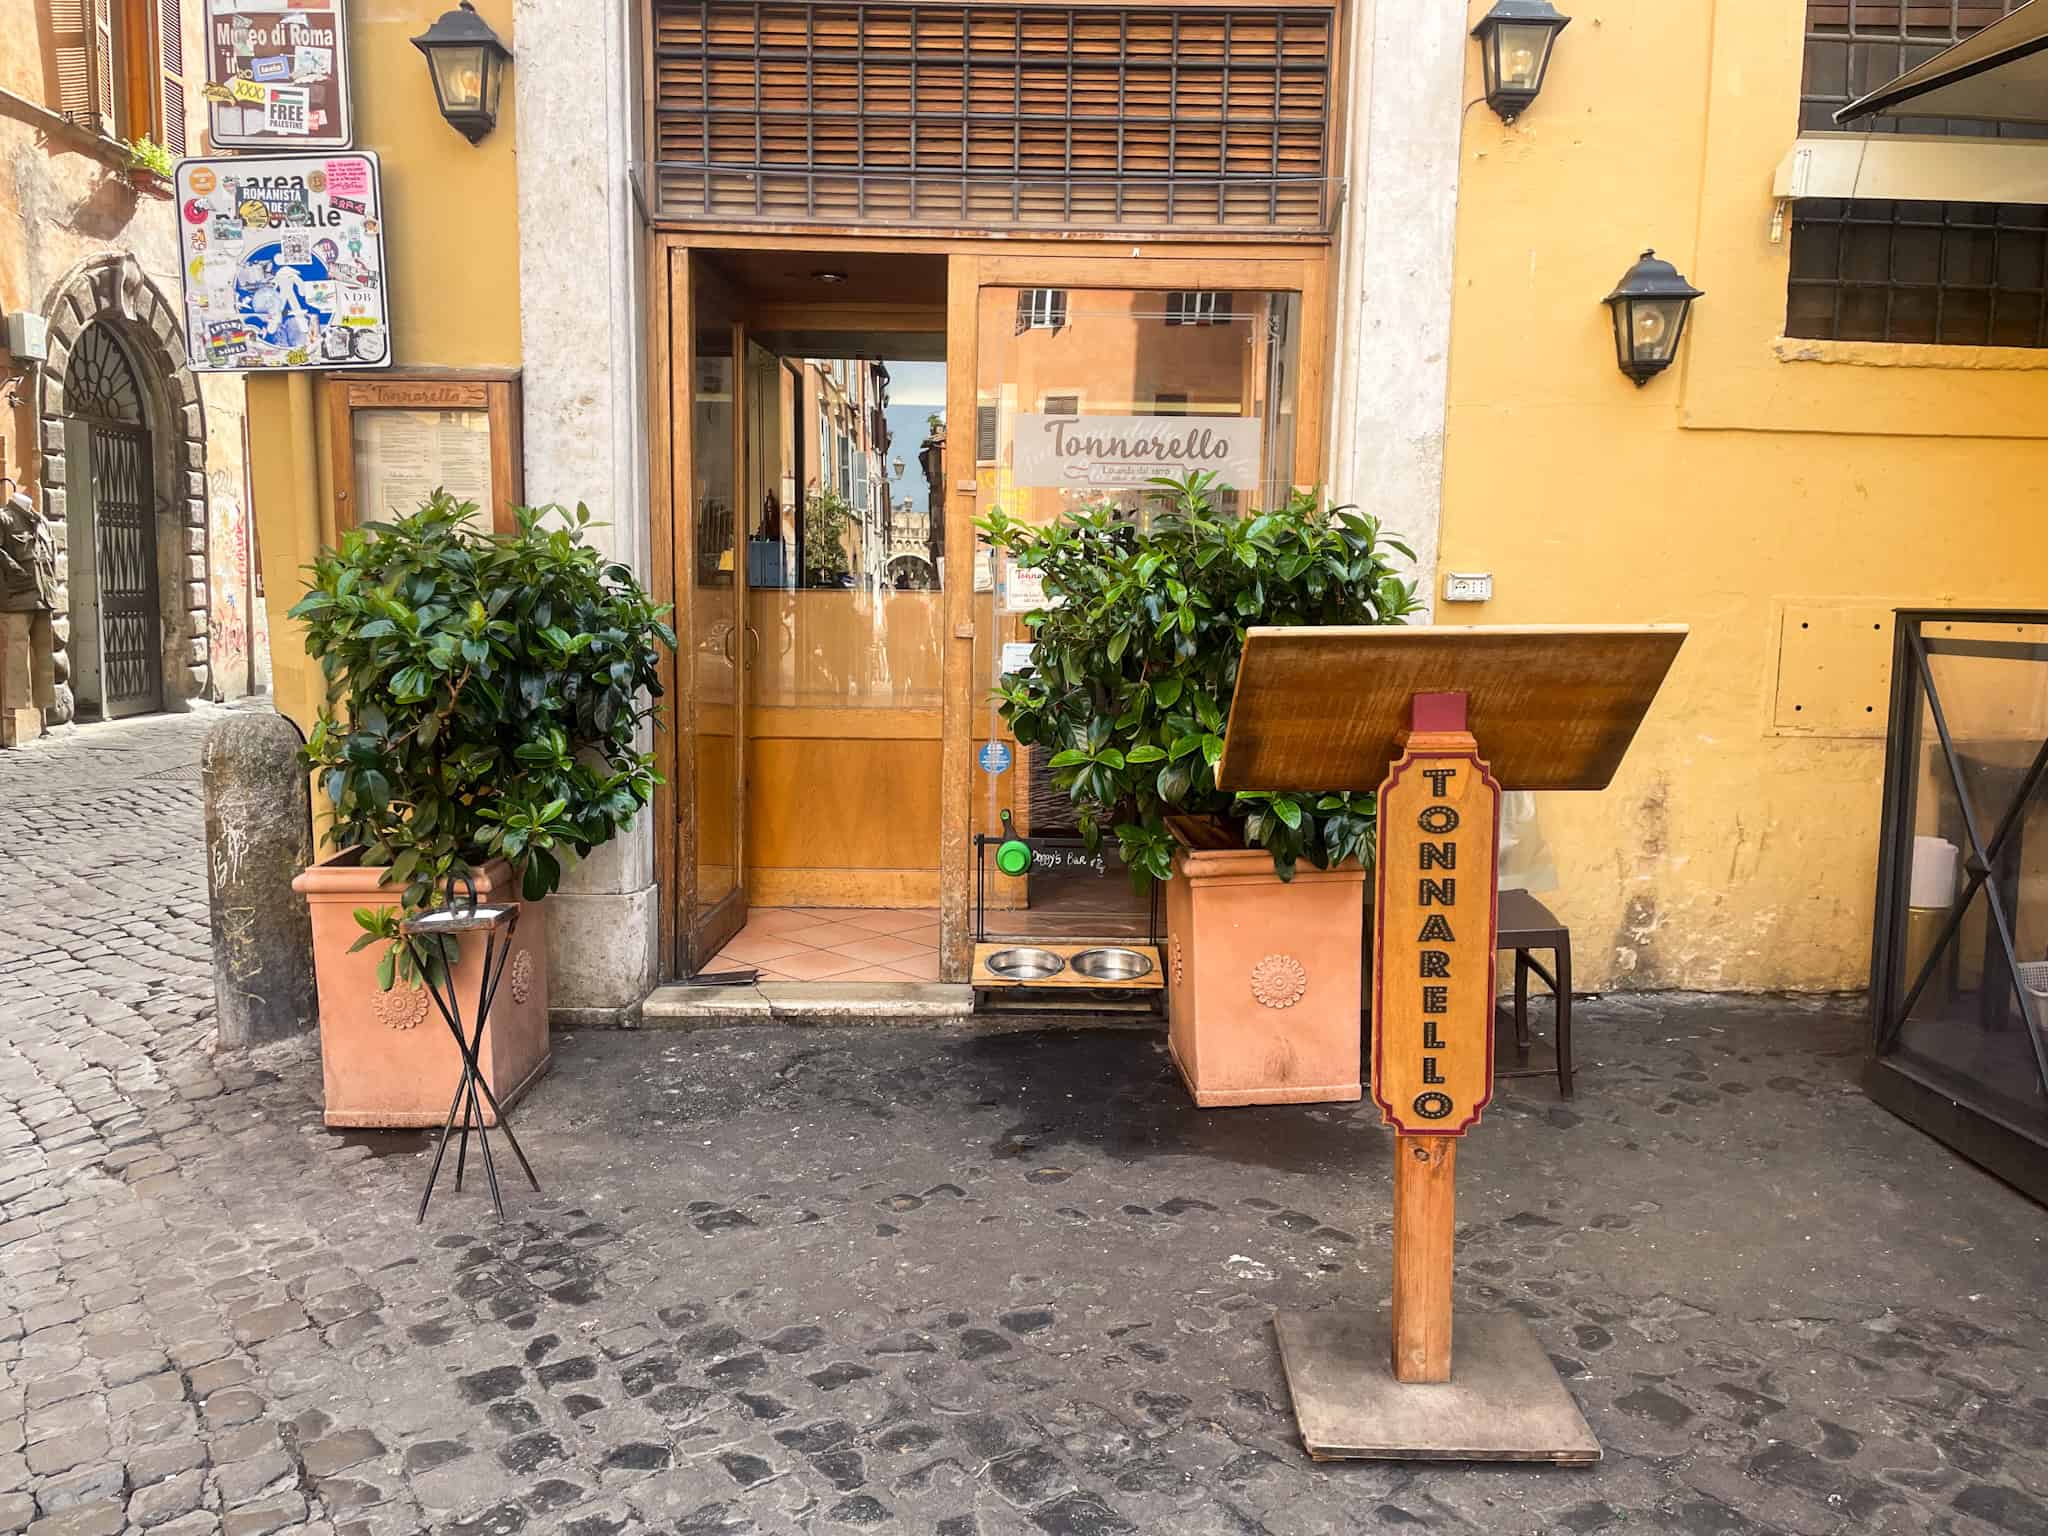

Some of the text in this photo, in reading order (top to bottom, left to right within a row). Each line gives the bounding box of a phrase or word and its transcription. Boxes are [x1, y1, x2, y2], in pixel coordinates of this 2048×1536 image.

[217, 23, 334, 47] Mueo di Roma
[270, 104, 303, 121] FREE
[269, 119, 303, 129] PALESTINE
[246, 176, 304, 189] area
[243, 188, 301, 201] ROMANISTA
[371, 384, 461, 402] Tonnarello
[1044, 417, 1229, 460] Tonnarello
[1413, 768, 1459, 1120] TONNARELLO
